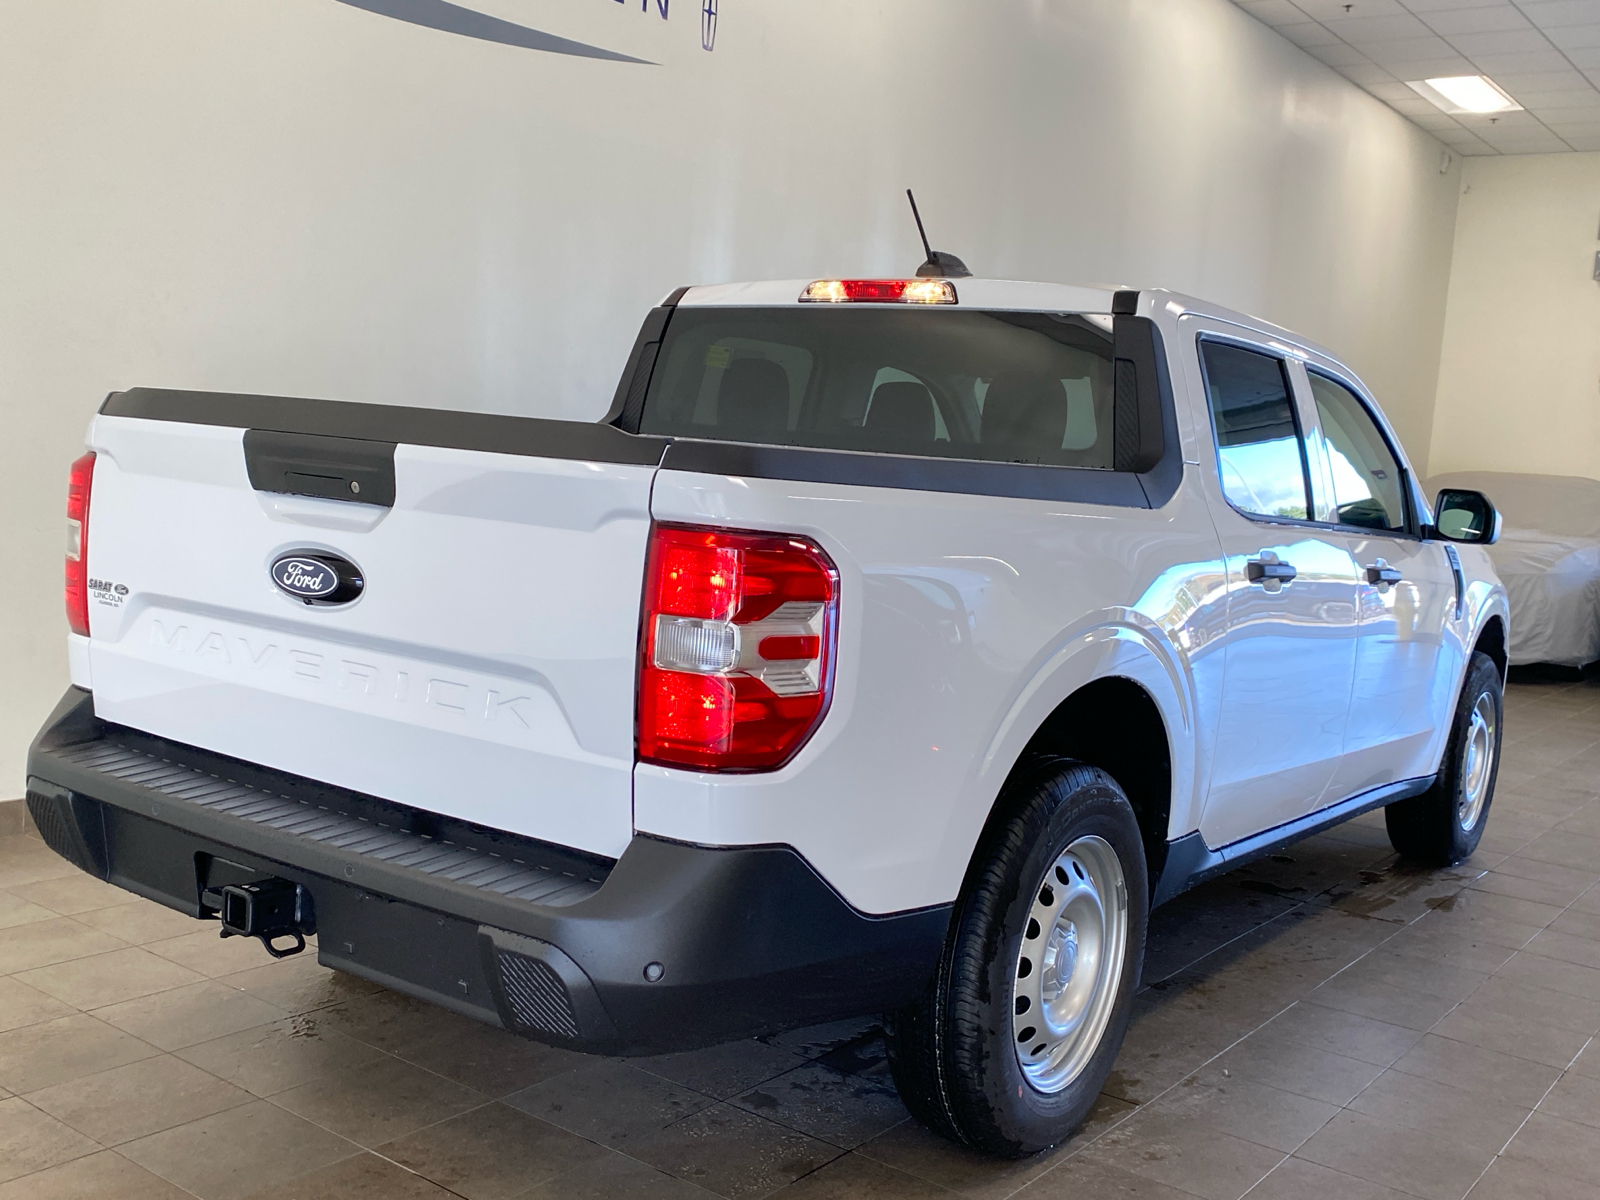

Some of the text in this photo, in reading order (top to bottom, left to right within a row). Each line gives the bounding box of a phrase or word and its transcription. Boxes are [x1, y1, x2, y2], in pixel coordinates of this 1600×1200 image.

[88, 578, 113, 593] SARAT
[283, 562, 325, 591] Ford
[93, 590, 123, 603] LINCOLN
[148, 619, 532, 729] MAVERICK
